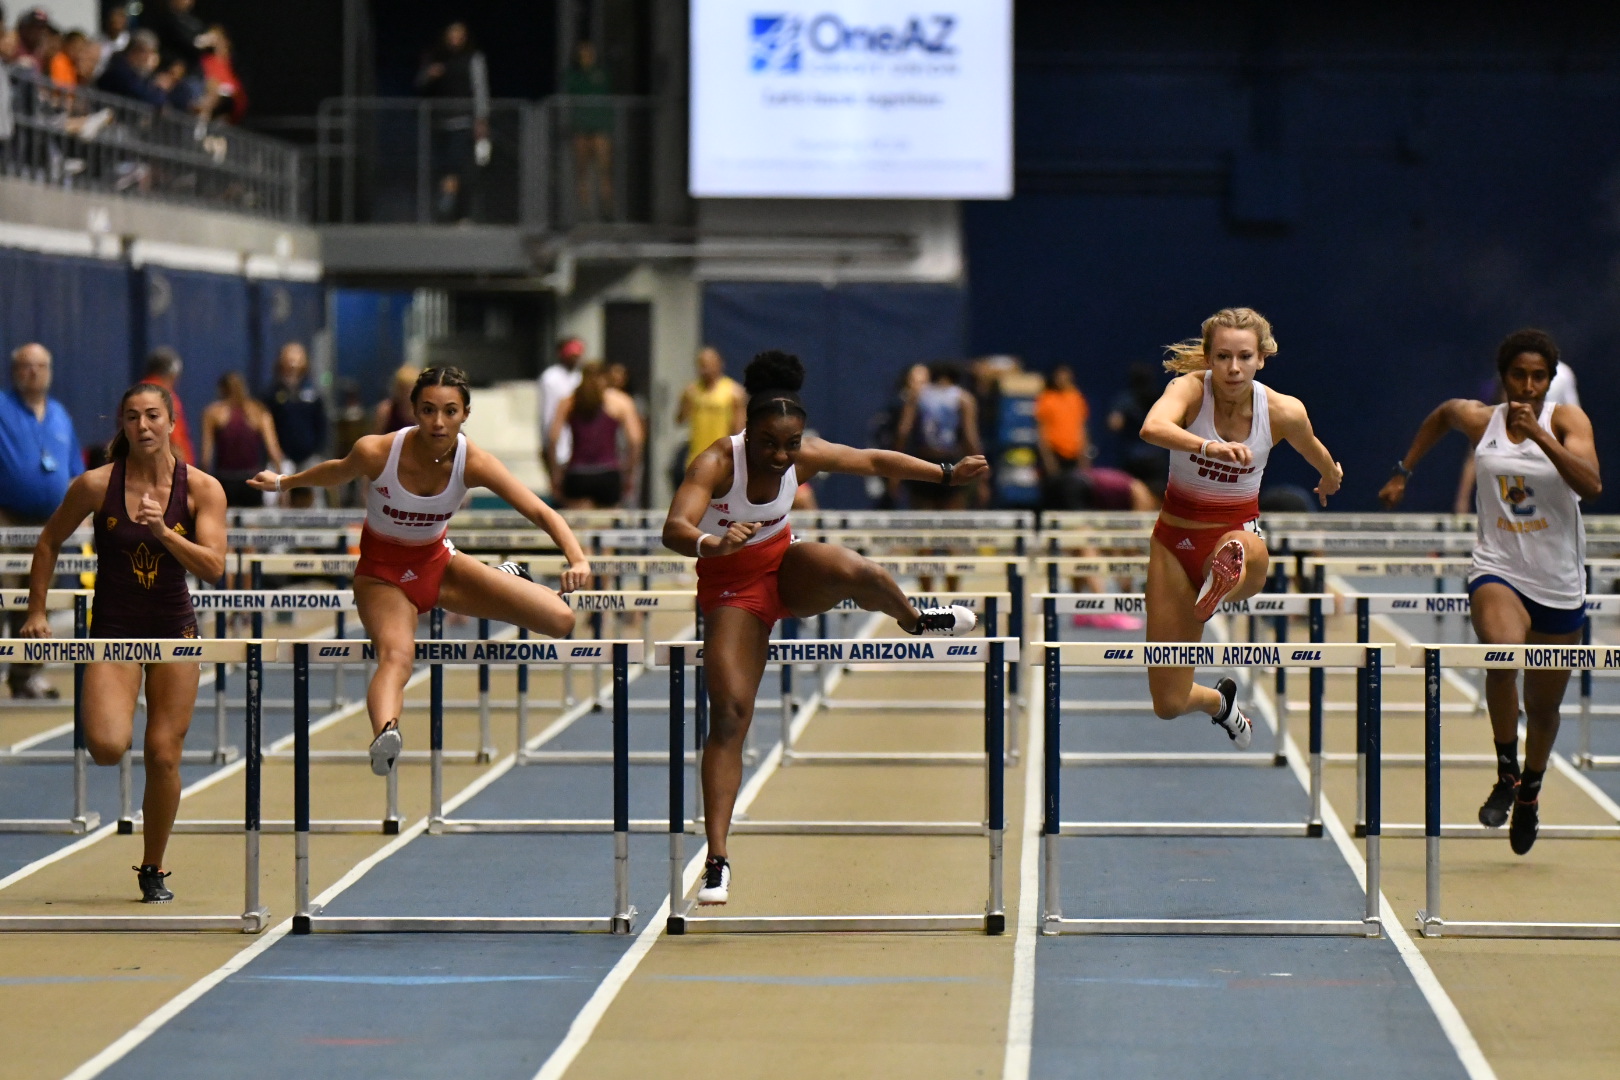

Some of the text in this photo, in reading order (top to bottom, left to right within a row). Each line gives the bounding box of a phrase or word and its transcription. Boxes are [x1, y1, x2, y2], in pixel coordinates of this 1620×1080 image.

[808, 13, 957, 54] OneAZ
[191, 594, 265, 608] ORTHERN
[271, 595, 341, 608] ARIZONA
[577, 595, 626, 609] ARIZONA
[1075, 599, 1105, 609] GILL
[1255, 601, 1285, 610] GILL
[1426, 598, 1471, 612] NORTH
[24, 643, 95, 661] NORTHERN
[103, 643, 162, 660] ARIZONA
[172, 646, 203, 656] GILL
[319, 643, 602, 660] GILL NHERN ARIZONA GILL
[767, 643, 978, 660] RTHERN ARIZONA GILL
[1103, 646, 1322, 665] GILL NORTHERN ARIZONA GILL
[1484, 651, 1515, 662] GILL
[1524, 648, 1596, 667] NORTHERN
